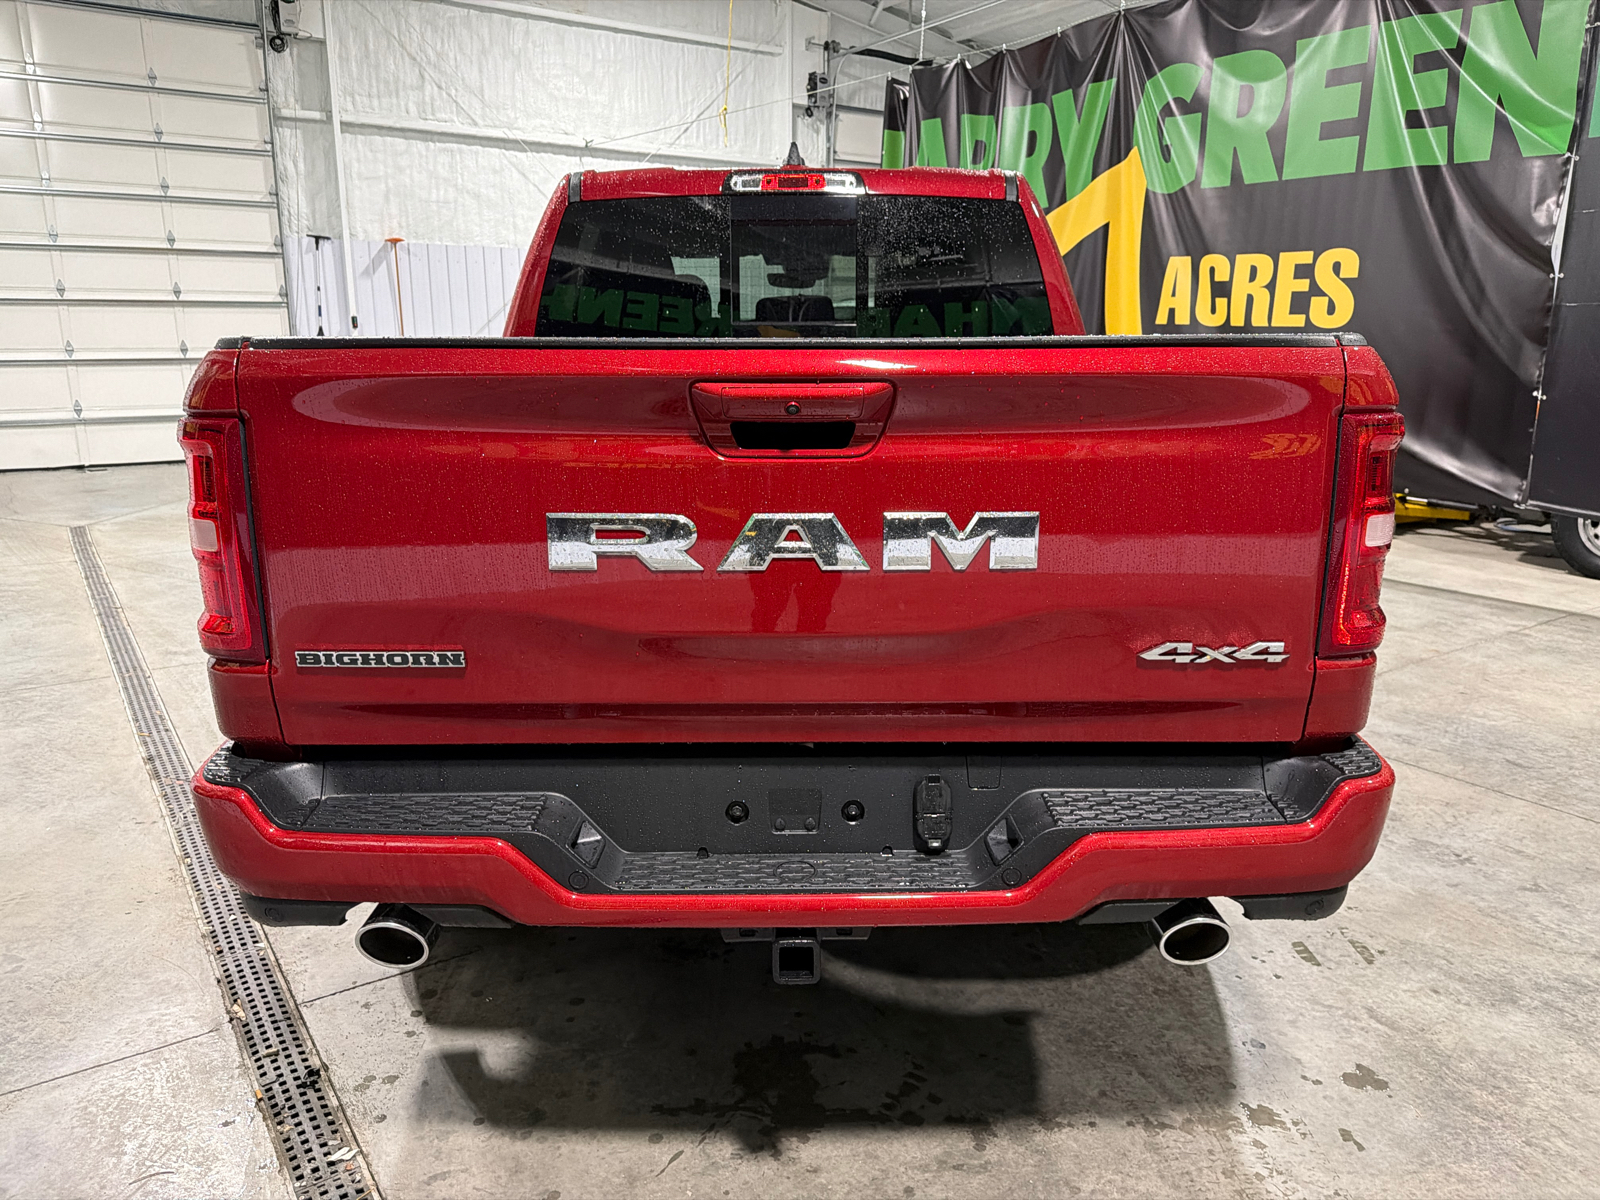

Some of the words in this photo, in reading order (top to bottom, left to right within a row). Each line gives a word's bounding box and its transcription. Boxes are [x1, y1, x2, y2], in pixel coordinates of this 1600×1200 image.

[880, 78, 1118, 209] ARRY
[1133, 0, 1590, 195] GREEN
[1155, 248, 1360, 329] ACRES
[546, 511, 1040, 571] RAM
[295, 651, 466, 667] BIGHORN
